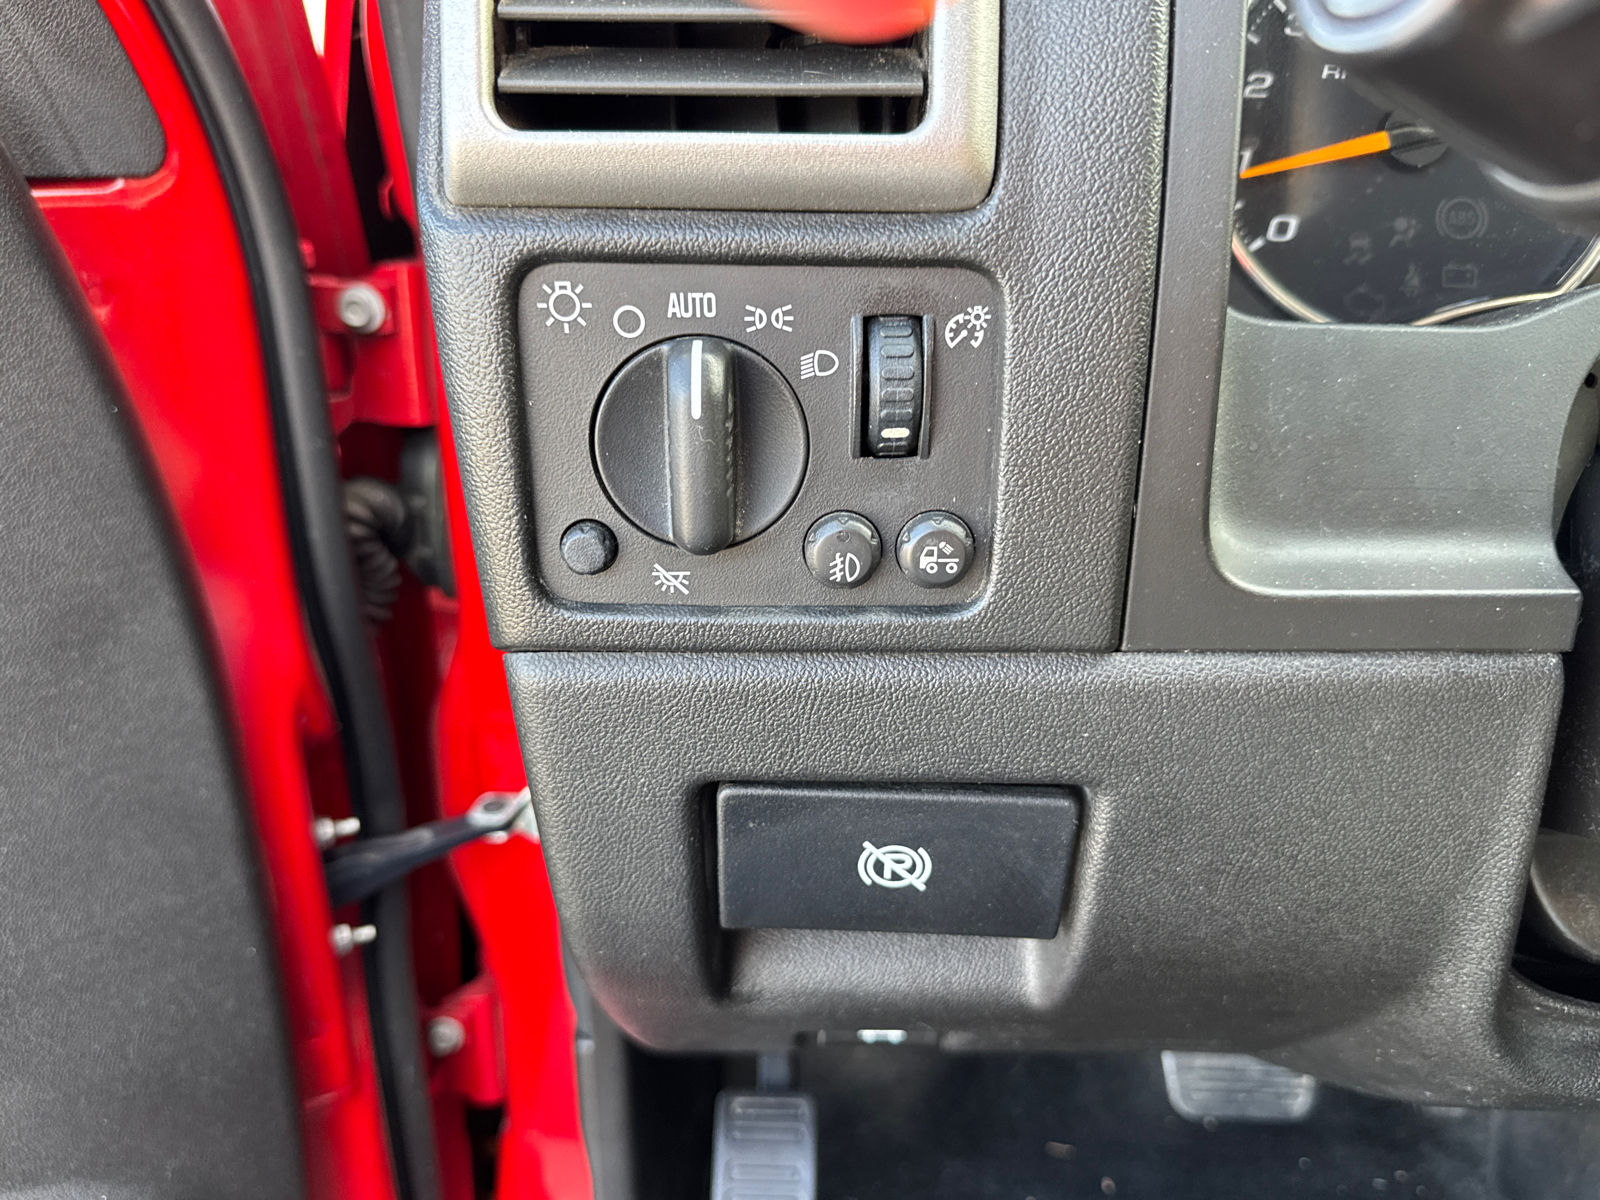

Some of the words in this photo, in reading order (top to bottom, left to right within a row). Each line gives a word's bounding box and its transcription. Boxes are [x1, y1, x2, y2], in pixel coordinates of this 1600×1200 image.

[1243, 72, 1274, 98] 2
[1240, 148, 1252, 174] 1
[1266, 214, 1300, 242] 0
[667, 292, 717, 318] AUTO
